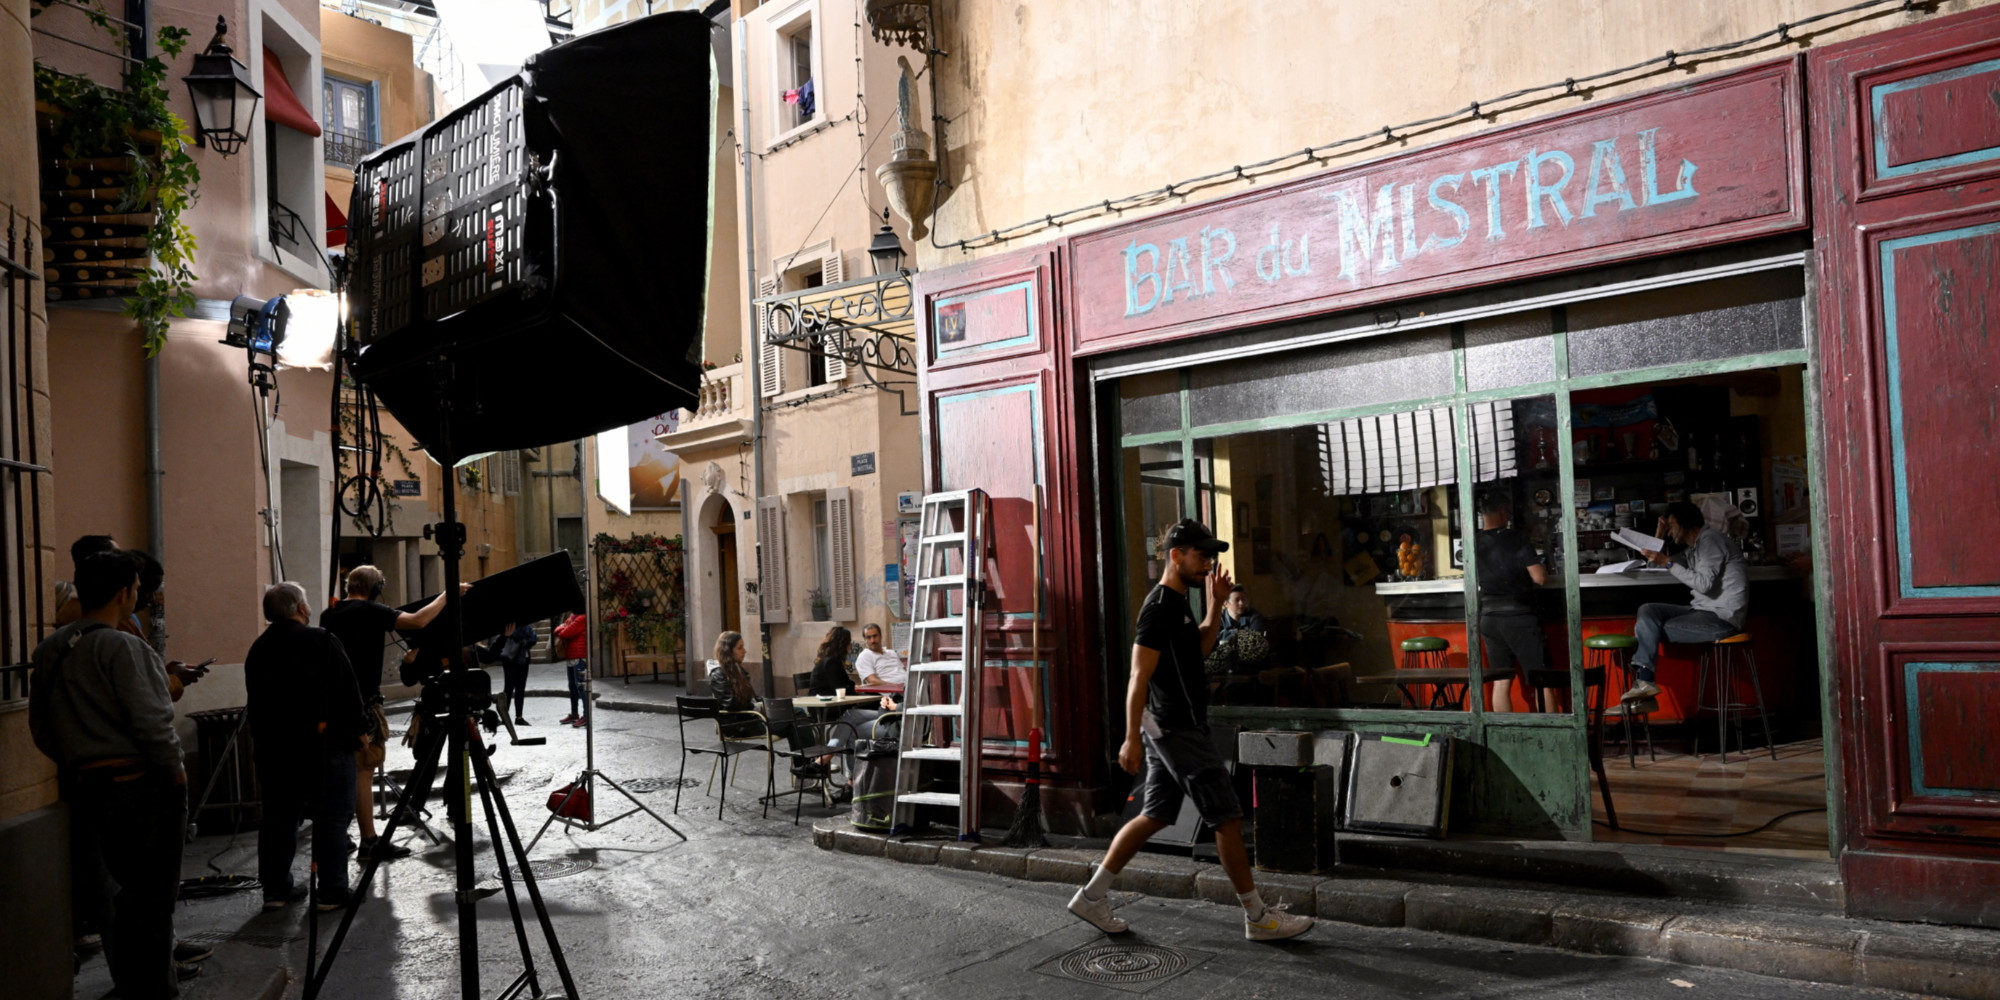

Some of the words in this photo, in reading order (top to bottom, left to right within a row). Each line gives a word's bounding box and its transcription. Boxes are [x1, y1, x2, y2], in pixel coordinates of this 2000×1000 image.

[494, 214, 504, 273] maxi
[1120, 223, 1237, 319] BAR
[1256, 223, 1310, 282] du
[1326, 127, 1700, 283] MISTRAL
